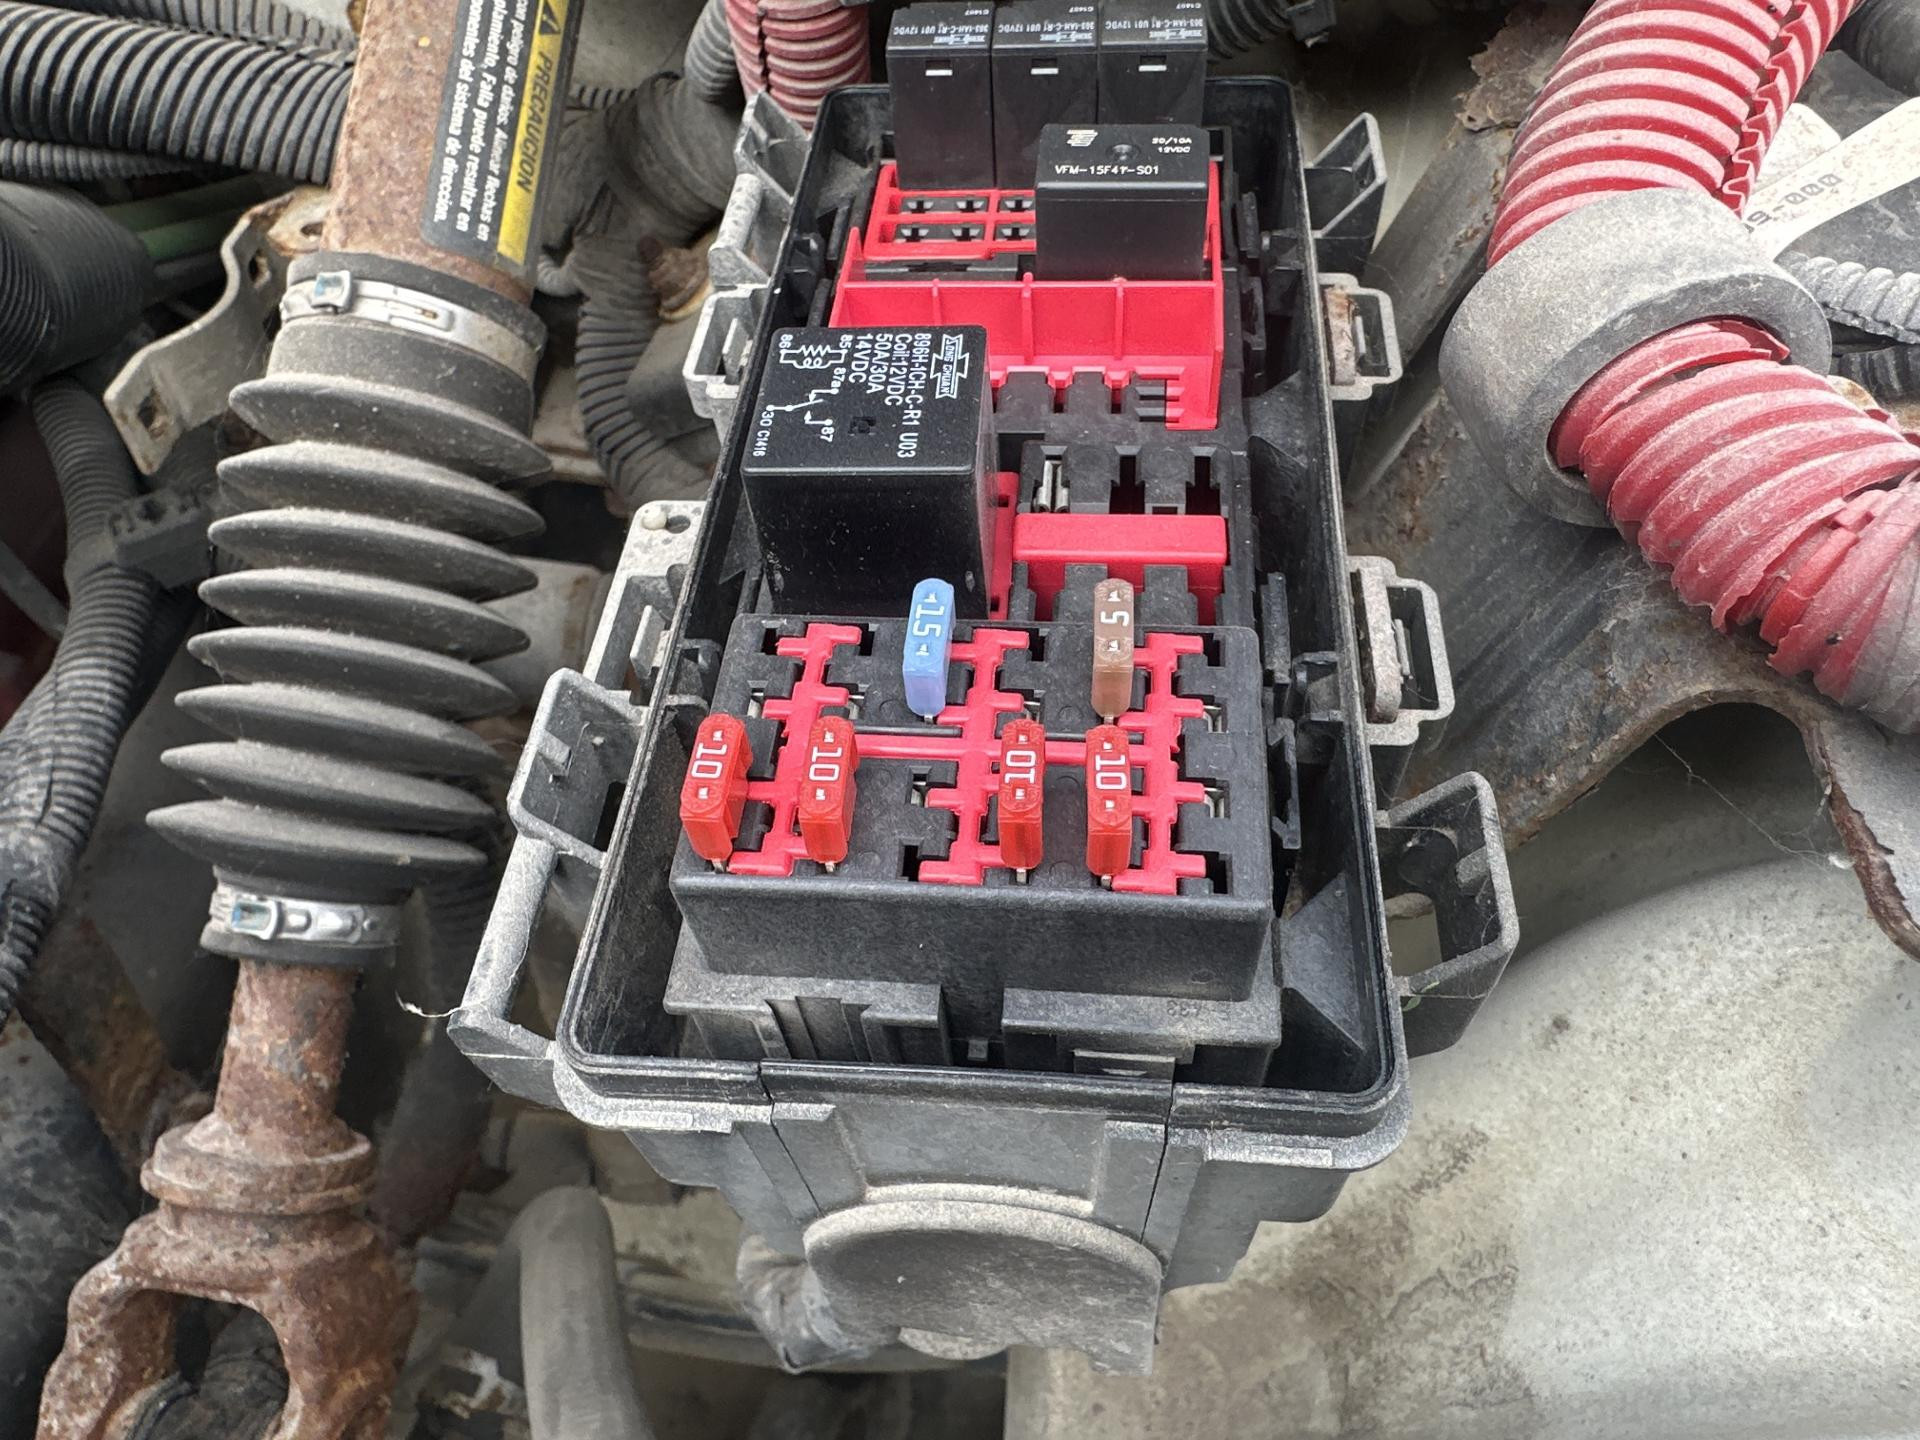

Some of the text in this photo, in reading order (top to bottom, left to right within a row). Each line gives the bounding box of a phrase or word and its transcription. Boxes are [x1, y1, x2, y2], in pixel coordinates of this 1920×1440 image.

[894, 25, 919, 35] 12VDC
[998, 23, 1024, 33] 12VDC
[1105, 20, 1131, 30] 12VDC
[506, 19, 524, 66] peligro
[458, 58, 475, 82] del
[503, 66, 518, 84] de
[477, 71, 497, 108] Falla
[449, 81, 471, 134] sistema
[517, 51, 552, 194] PRECAUCION
[445, 136, 462, 155] de
[469, 107, 487, 153] puede
[489, 127, 508, 175] Alinear
[460, 154, 480, 212] resultar
[479, 175, 500, 223] flechas
[456, 212, 470, 231] en
[477, 223, 490, 241] en
[779, 334, 793, 349] 86
[840, 334, 853, 349] 85
[848, 334, 873, 384] 14VDC
[866, 333, 893, 394] 50A/30A
[885, 334, 912, 406] Coil:12VDC
[830, 367, 846, 387] 87a
[940, 364, 953, 394] CHUAN
[897, 333, 932, 458] 896H-1CH-C-R1 U03
[760, 411, 774, 427] 30
[820, 427, 835, 443] 87
[912, 604, 944, 637] 15
[1100, 611, 1129, 627] 5
[691, 743, 727, 779] 10
[808, 746, 842, 781] 10
[1004, 750, 1037, 784] 10
[1095, 754, 1127, 790] 10
